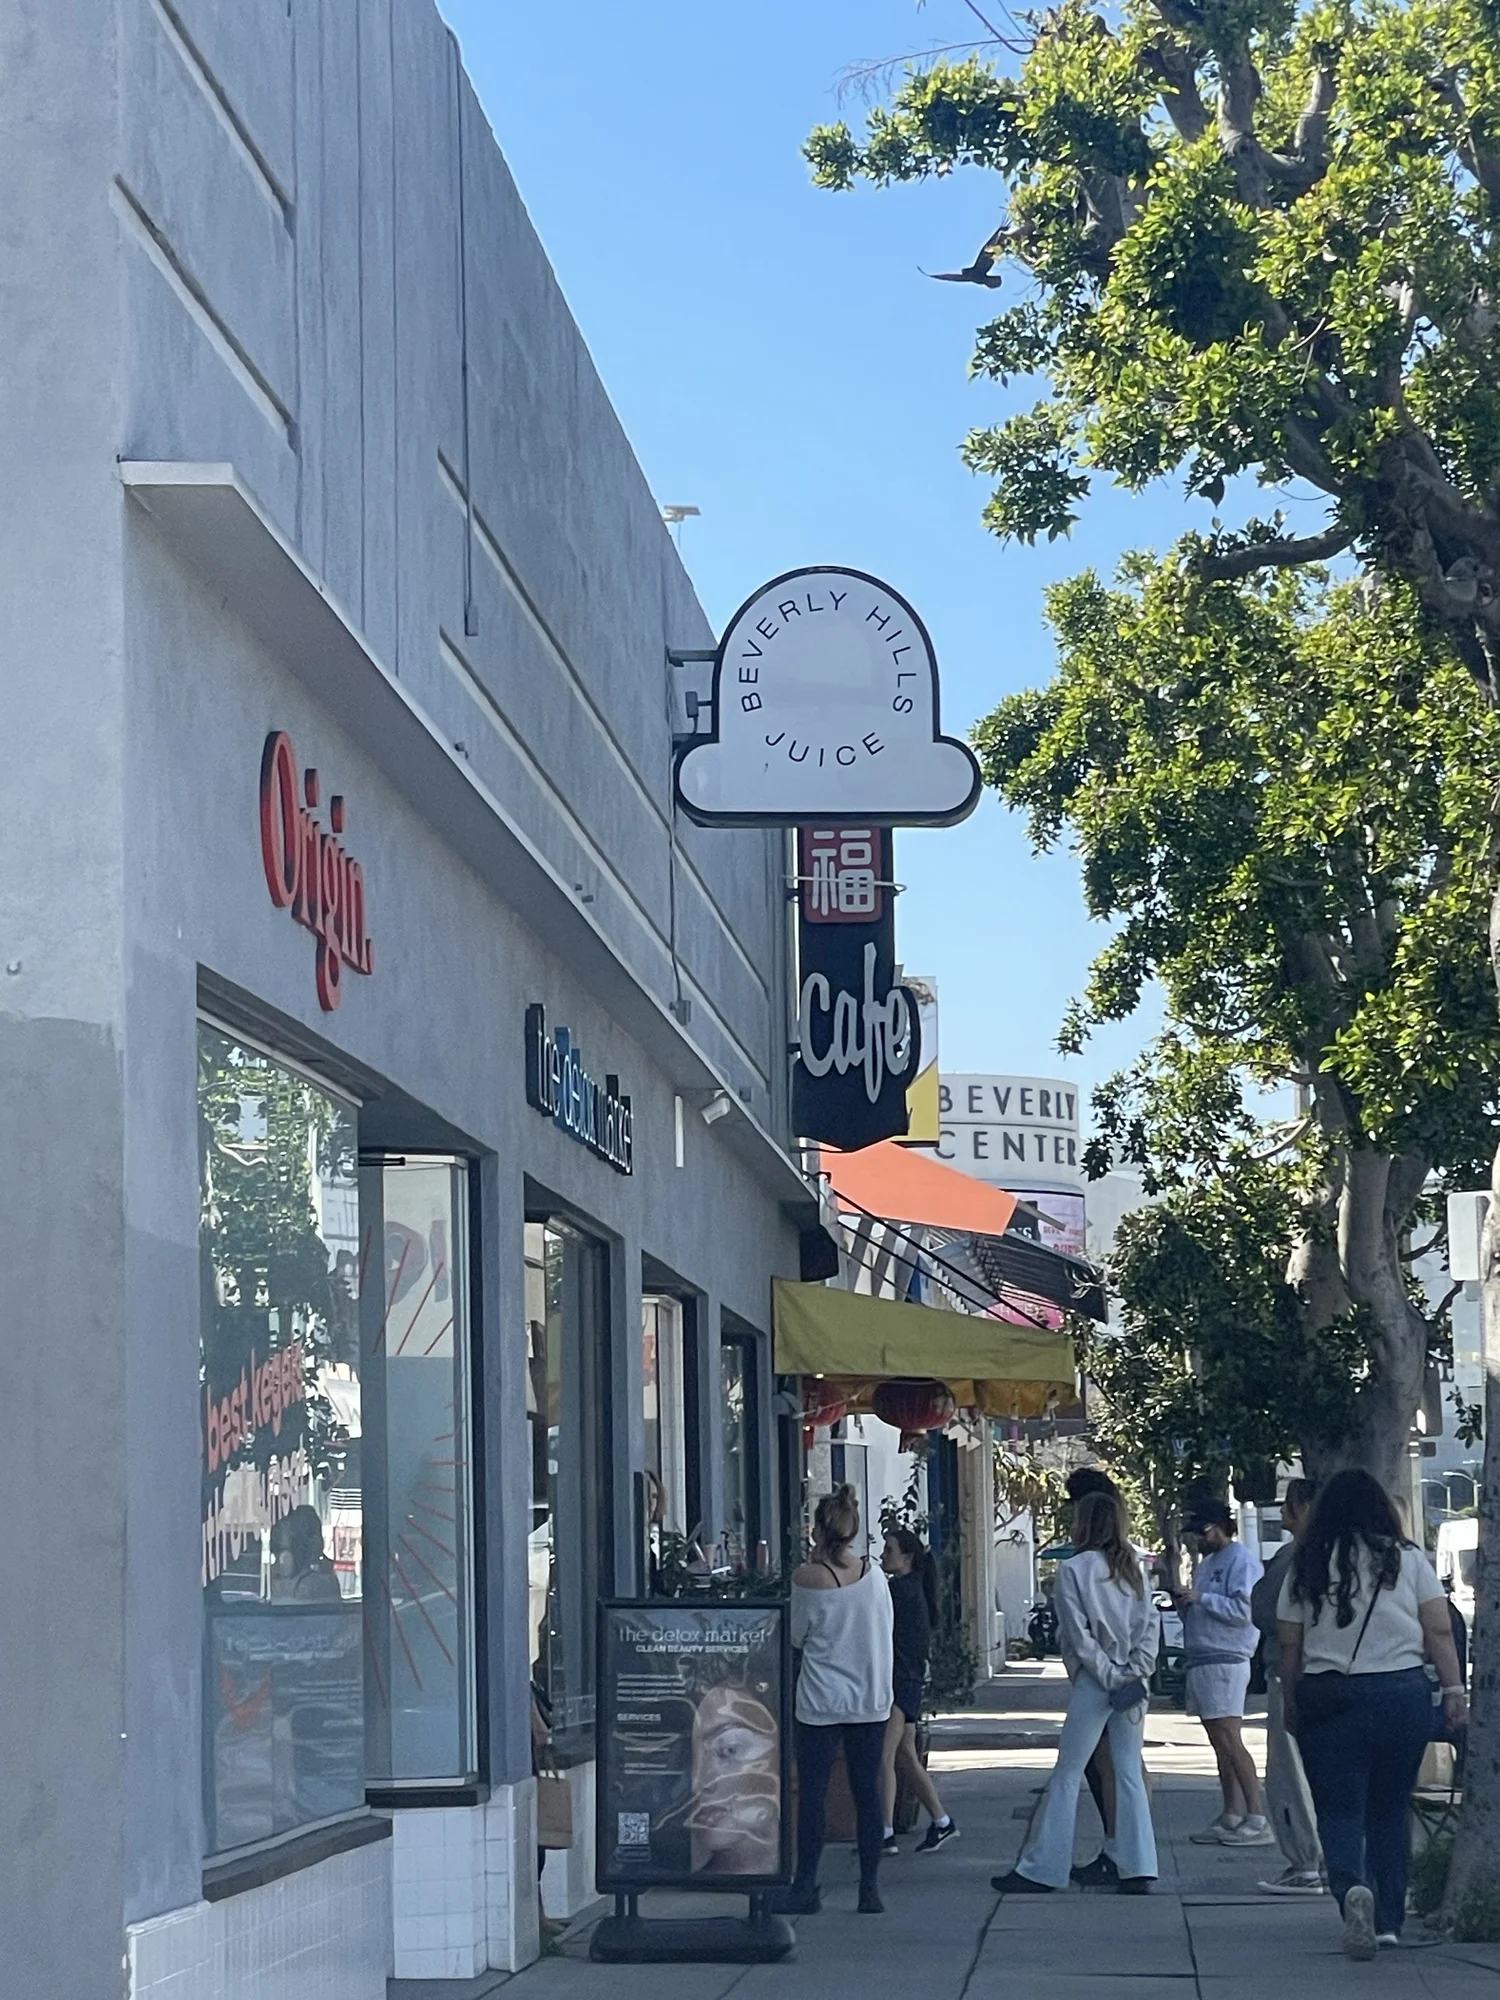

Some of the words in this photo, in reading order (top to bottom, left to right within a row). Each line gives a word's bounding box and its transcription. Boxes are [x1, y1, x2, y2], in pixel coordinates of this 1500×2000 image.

[738, 590, 848, 713] BEVERLY
[865, 605, 917, 714] HILLS
[765, 732, 885, 768] JUICE
[811, 829, 875, 916] 福
[938, 1084, 1075, 1121] BEVERLY
[934, 1130, 1077, 1166] CENTER
[207, 1365, 252, 1474] best
[620, 1626, 648, 1642] the
[652, 1626, 699, 1642] detox
[705, 1626, 766, 1642] market
[635, 1644, 666, 1653] CLEAN
[617, 1713, 661, 1722] SERVICES
